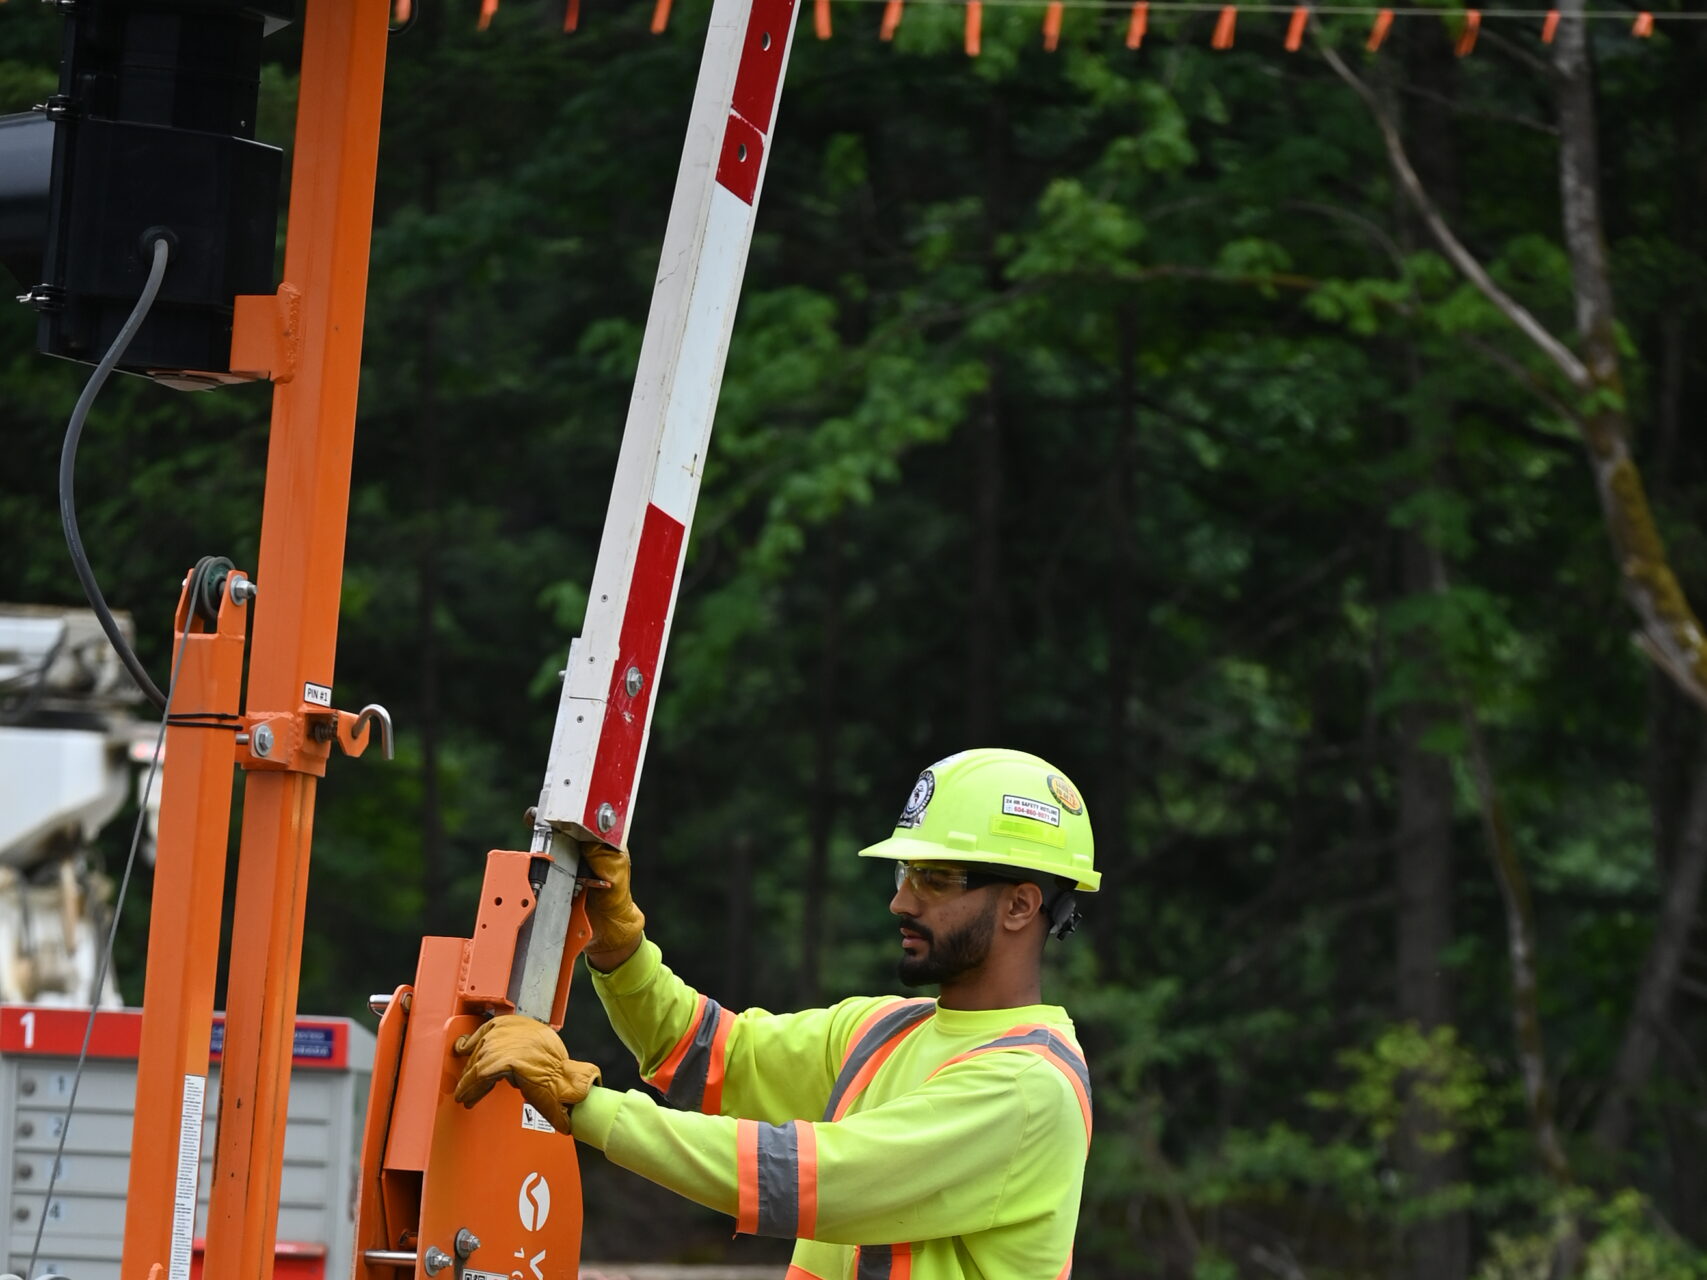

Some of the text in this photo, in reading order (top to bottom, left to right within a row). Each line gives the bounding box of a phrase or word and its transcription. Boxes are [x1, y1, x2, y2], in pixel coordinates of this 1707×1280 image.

[307, 688, 328, 702] PIN #1
[1021, 801, 1039, 809] SAFETY
[20, 1011, 36, 1049] 1
[513, 1247, 525, 1259] 1
